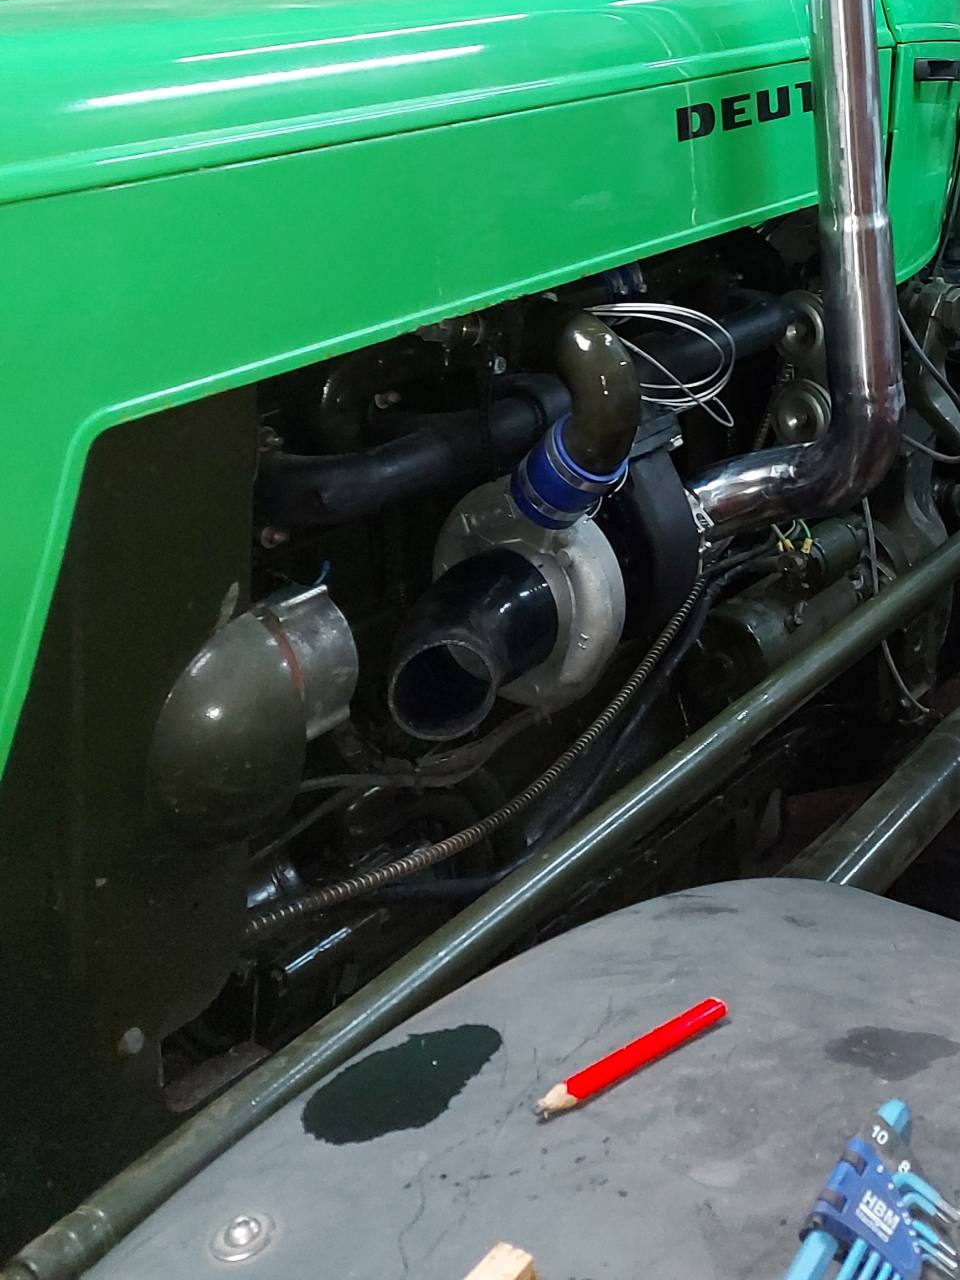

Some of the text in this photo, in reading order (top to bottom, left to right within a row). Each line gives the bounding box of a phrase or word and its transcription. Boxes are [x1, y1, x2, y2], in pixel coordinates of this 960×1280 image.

[676, 81, 814, 142] DEUT
[872, 1125, 889, 1145] 10
[862, 1190, 900, 1230] HBM
